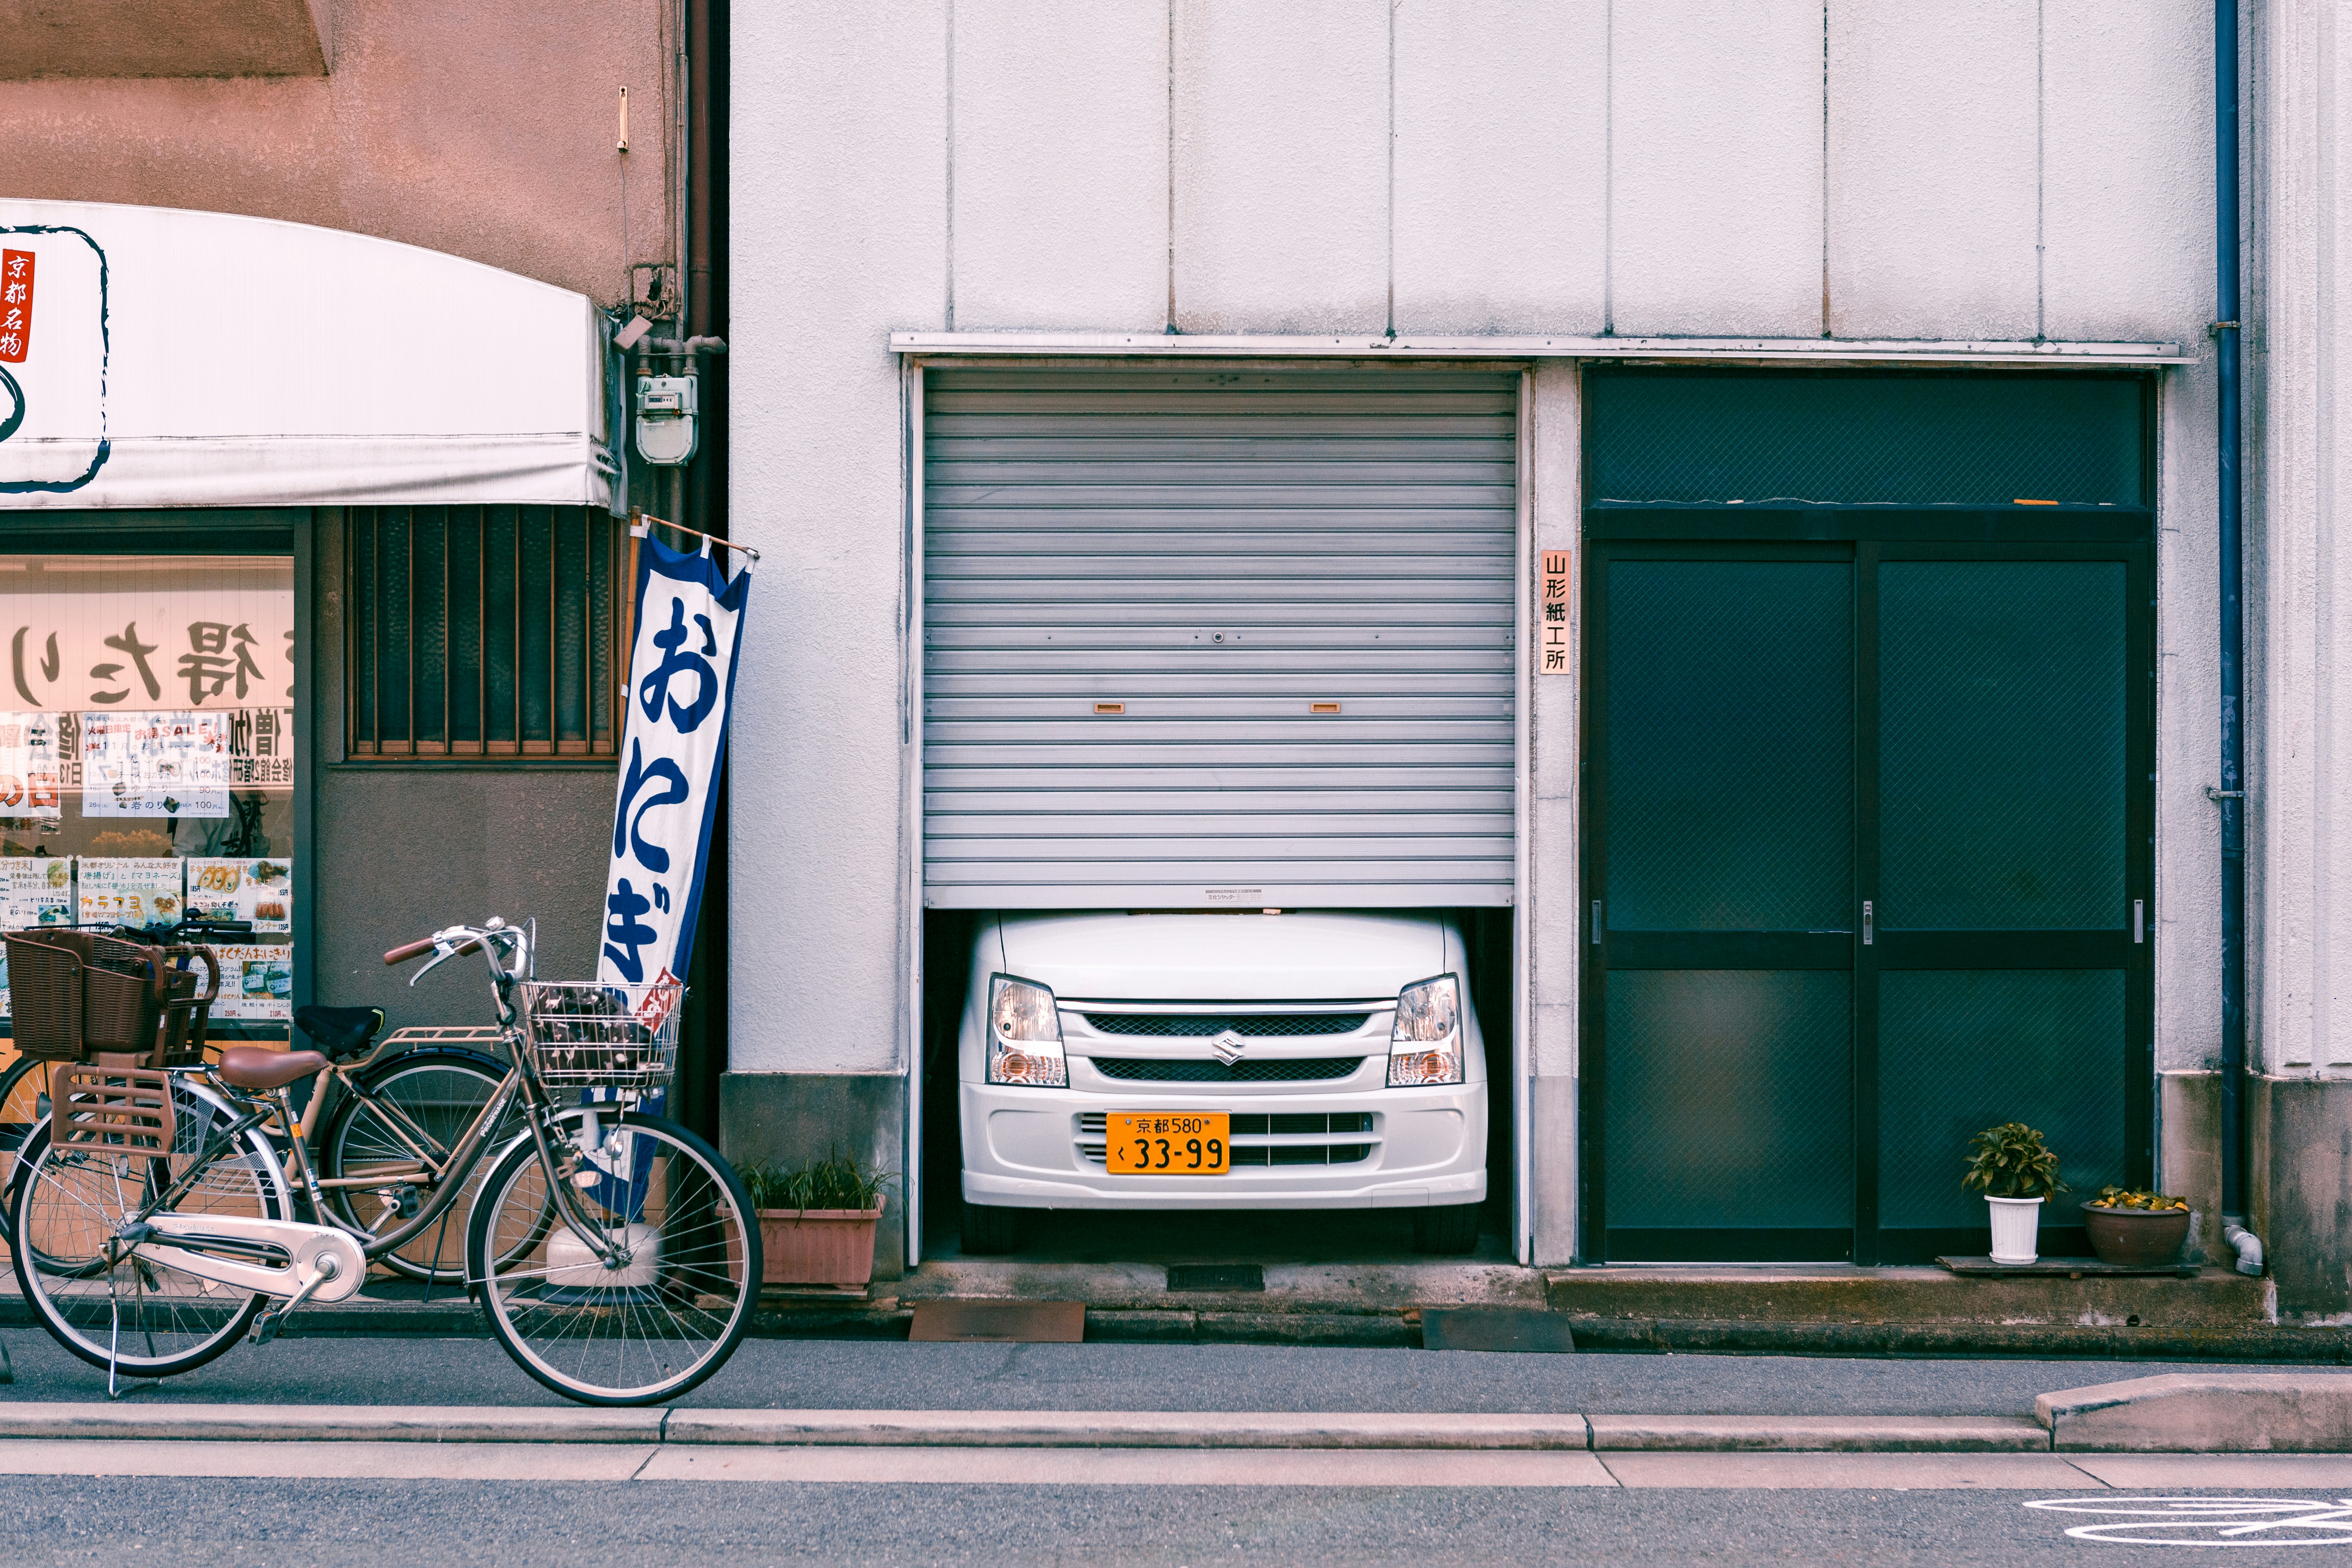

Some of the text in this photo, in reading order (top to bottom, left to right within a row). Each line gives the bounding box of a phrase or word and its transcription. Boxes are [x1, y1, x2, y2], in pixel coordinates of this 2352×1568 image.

[0, 256, 29, 357] 京都名物
[1546, 555, 1565, 669] 山形紙工所
[88, 724, 131, 735] 火曜日限定
[117, 771, 169, 779] チーズおかか
[131, 784, 168, 792] ゆかり
[131, 801, 163, 809] 岩のり
[0, 860, 32, 871] 分つき米』
[131, 871, 181, 880] 『マヨネーズ』
[80, 896, 140, 909] カラマヨ
[480, 1097, 508, 1137] PROMENADE
[1118, 1138, 1223, 1168] く 33-99
[174, 1222, 215, 1232] PROMENADE
